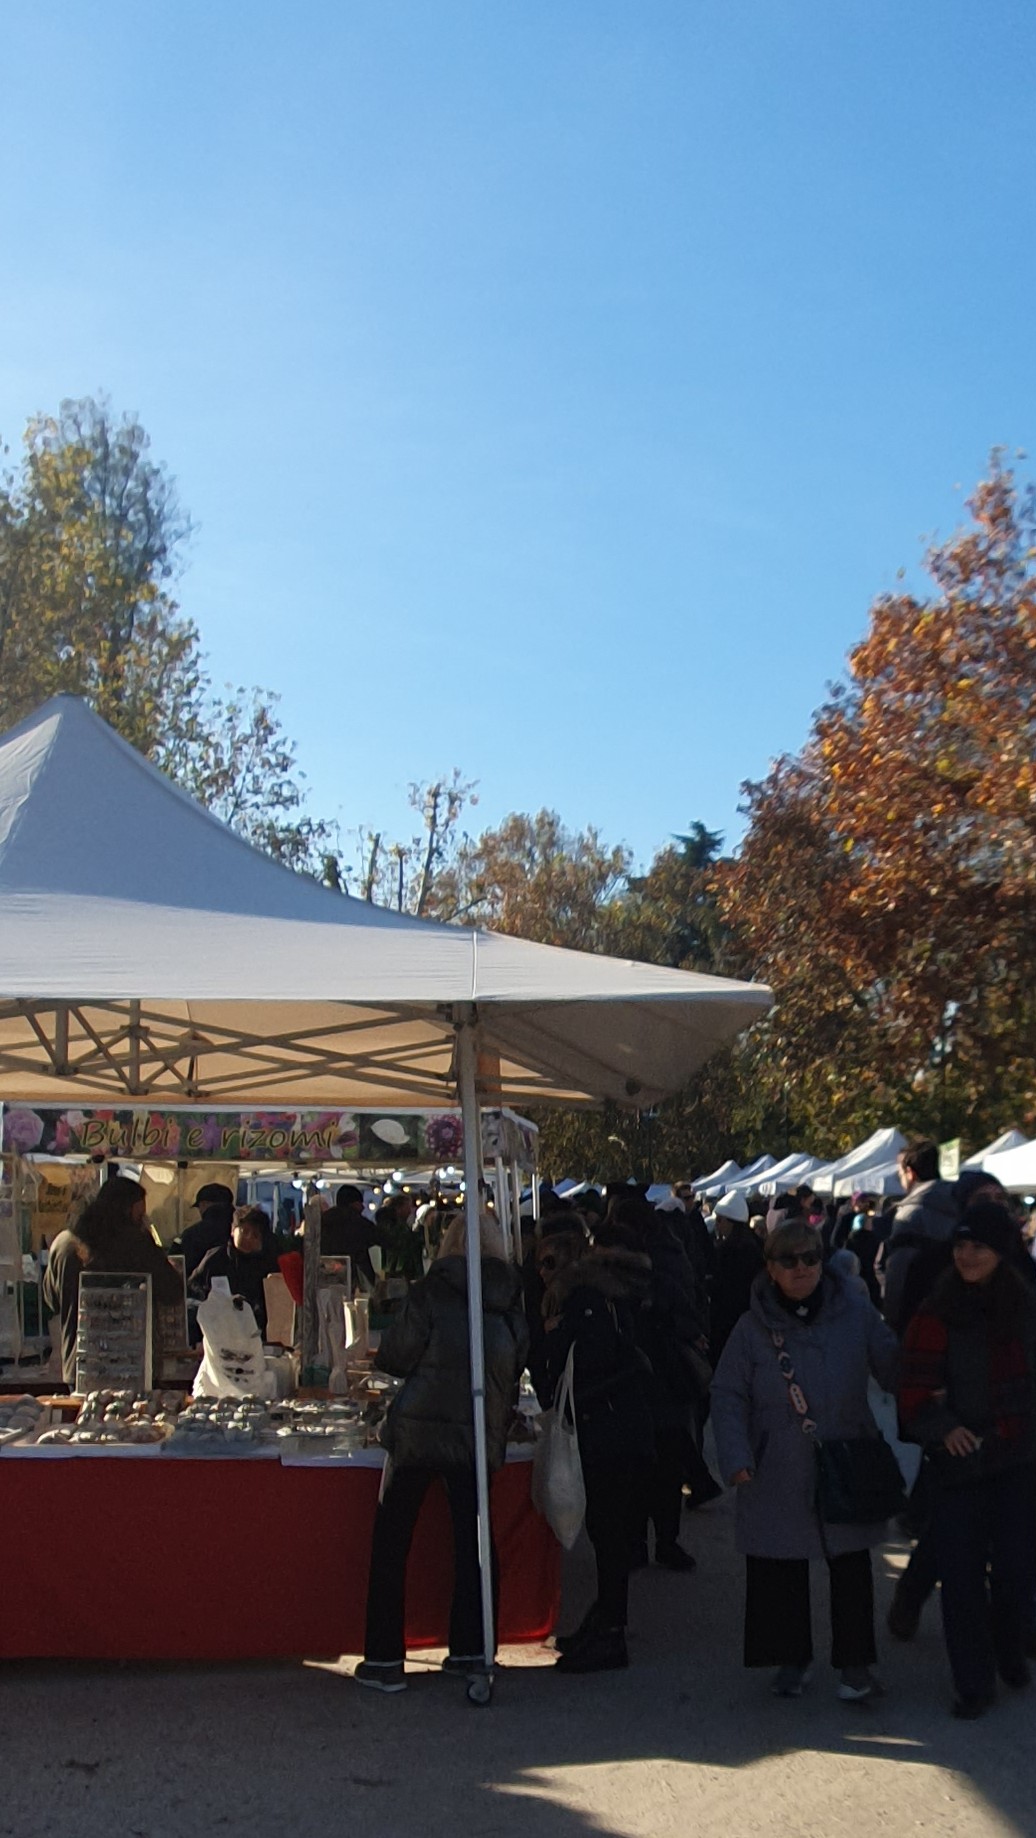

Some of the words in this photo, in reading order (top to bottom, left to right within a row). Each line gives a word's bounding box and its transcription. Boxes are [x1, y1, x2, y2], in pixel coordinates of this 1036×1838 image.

[81, 1118, 174, 1147] Bulbi
[187, 1126, 205, 1147] e
[221, 1121, 337, 1149] rizomi
